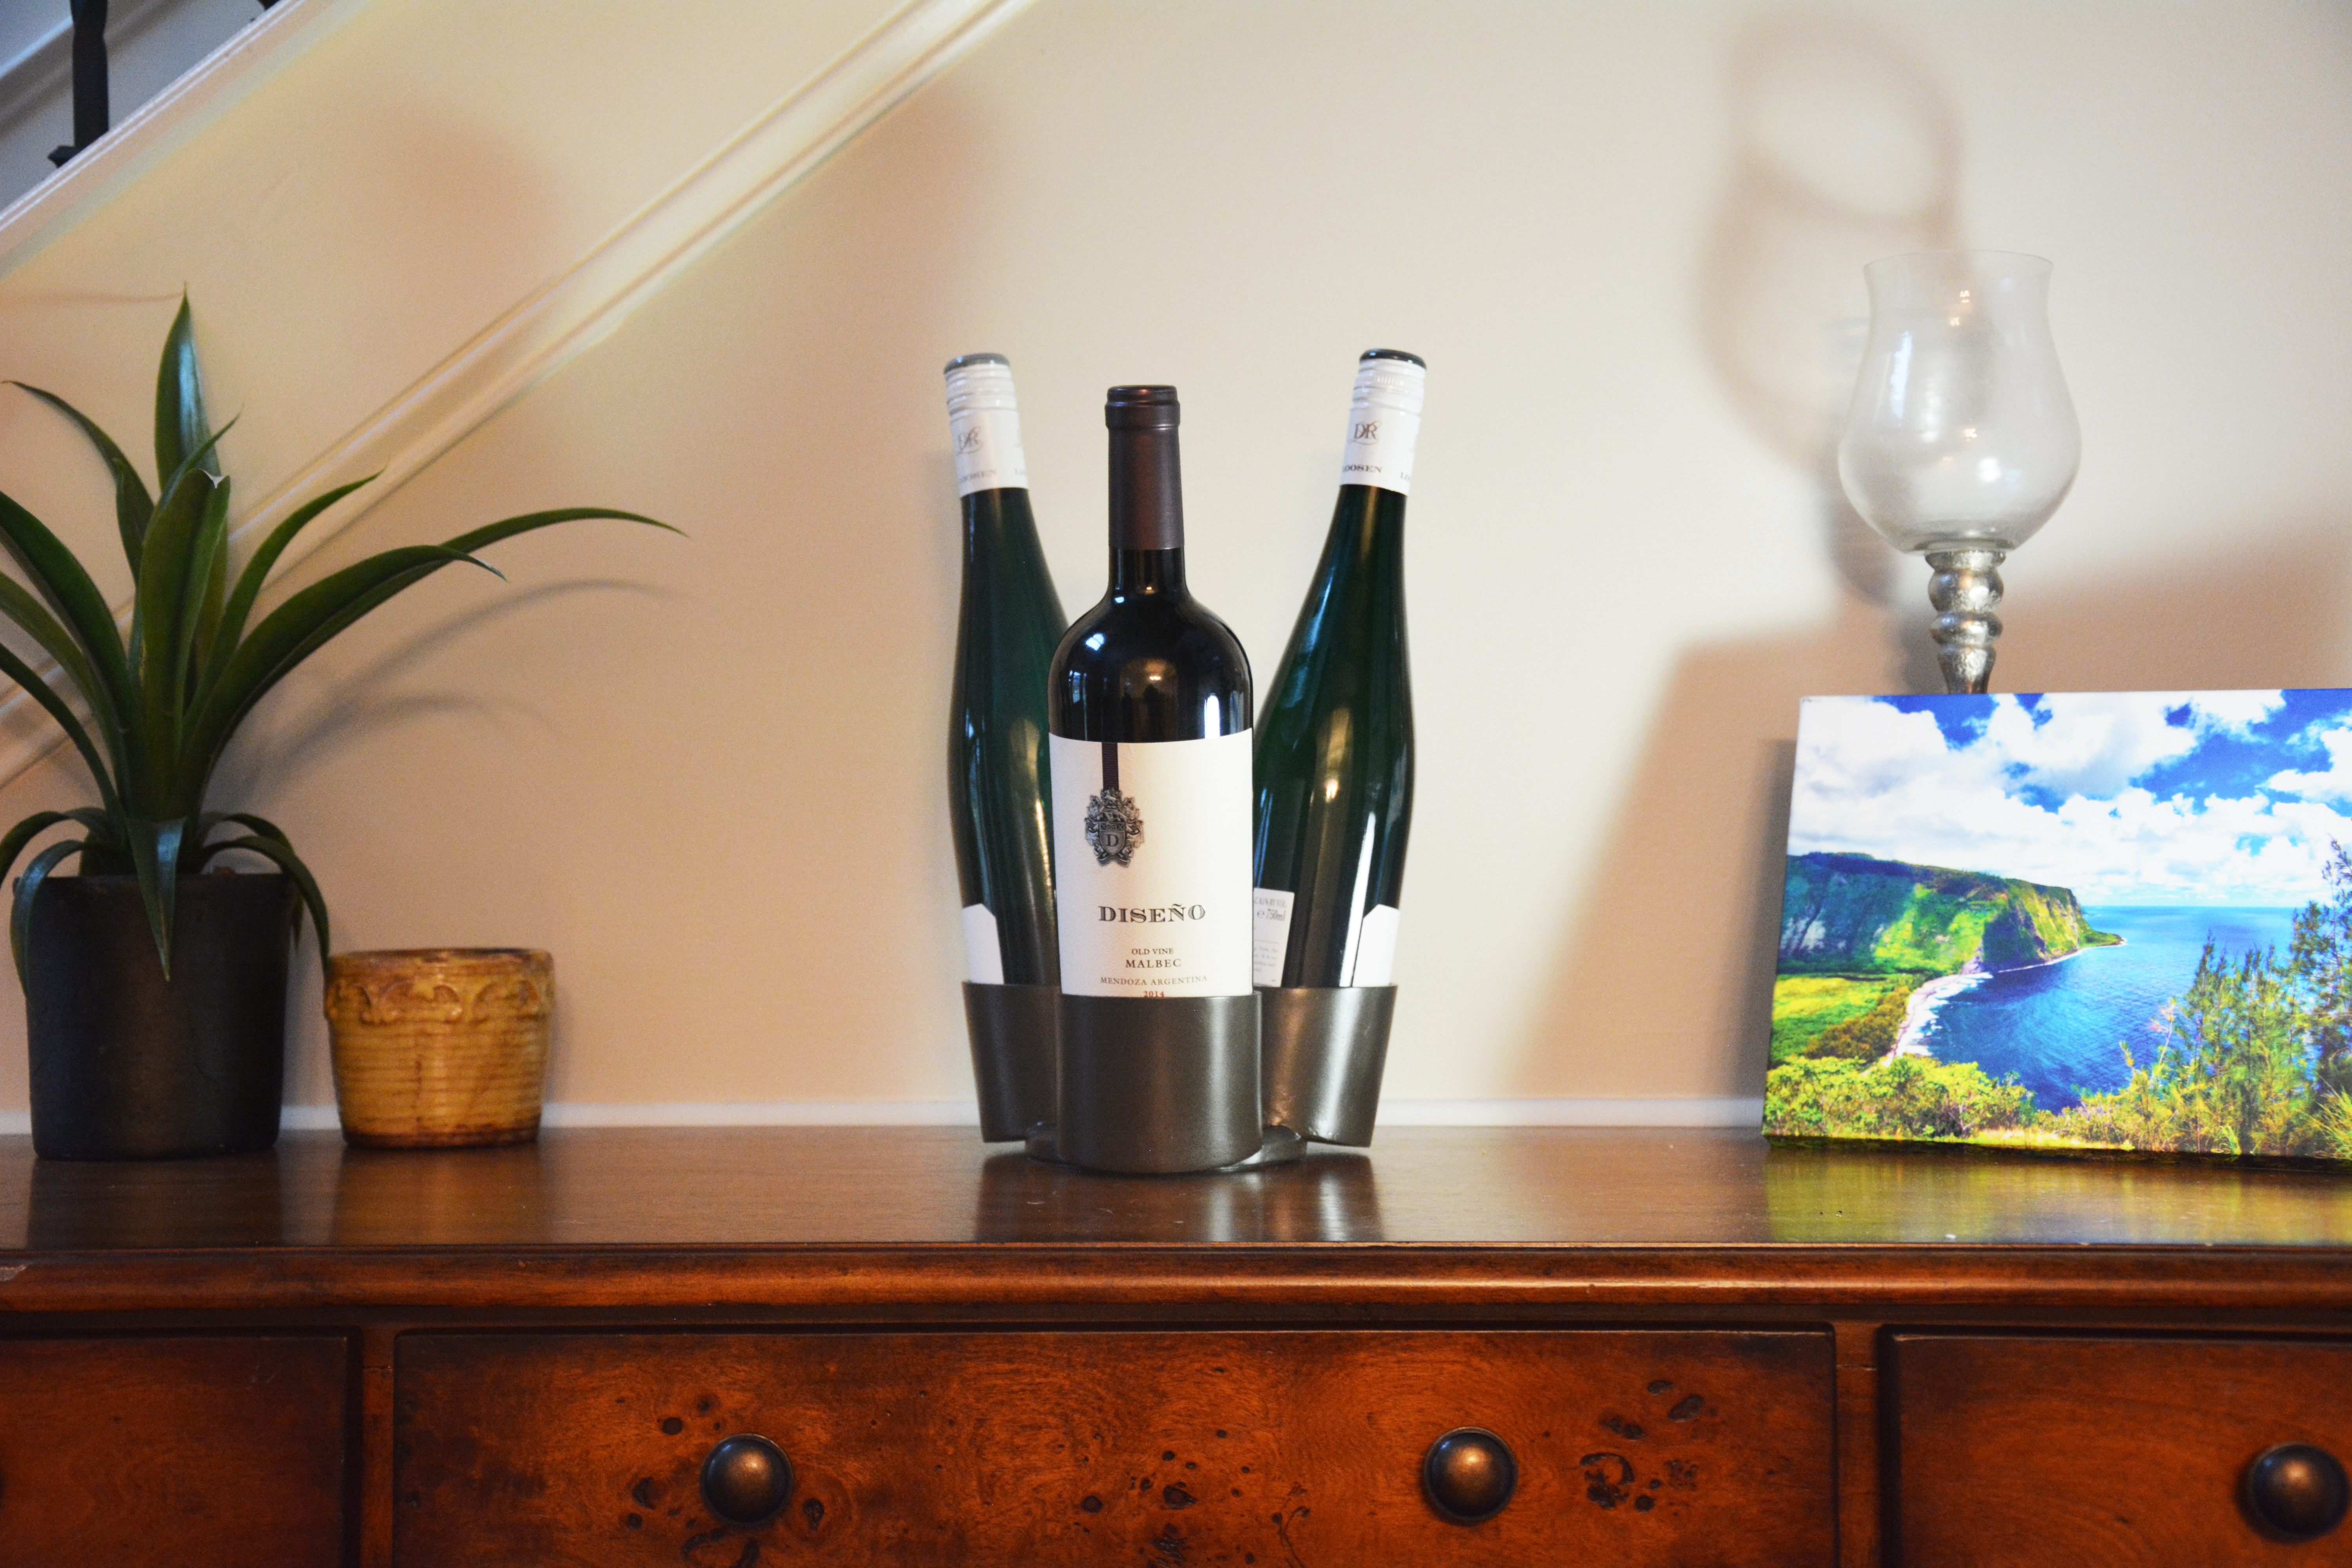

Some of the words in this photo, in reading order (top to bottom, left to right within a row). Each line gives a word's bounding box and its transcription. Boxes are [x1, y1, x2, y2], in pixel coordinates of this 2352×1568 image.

[1106, 834, 1119, 847] D
[1098, 904, 1206, 923] DISEÑO
[1125, 959, 1181, 968] MALBEC
[1100, 976, 1147, 985] MENDOZA
[1151, 975, 1207, 985] ARGENTINA
